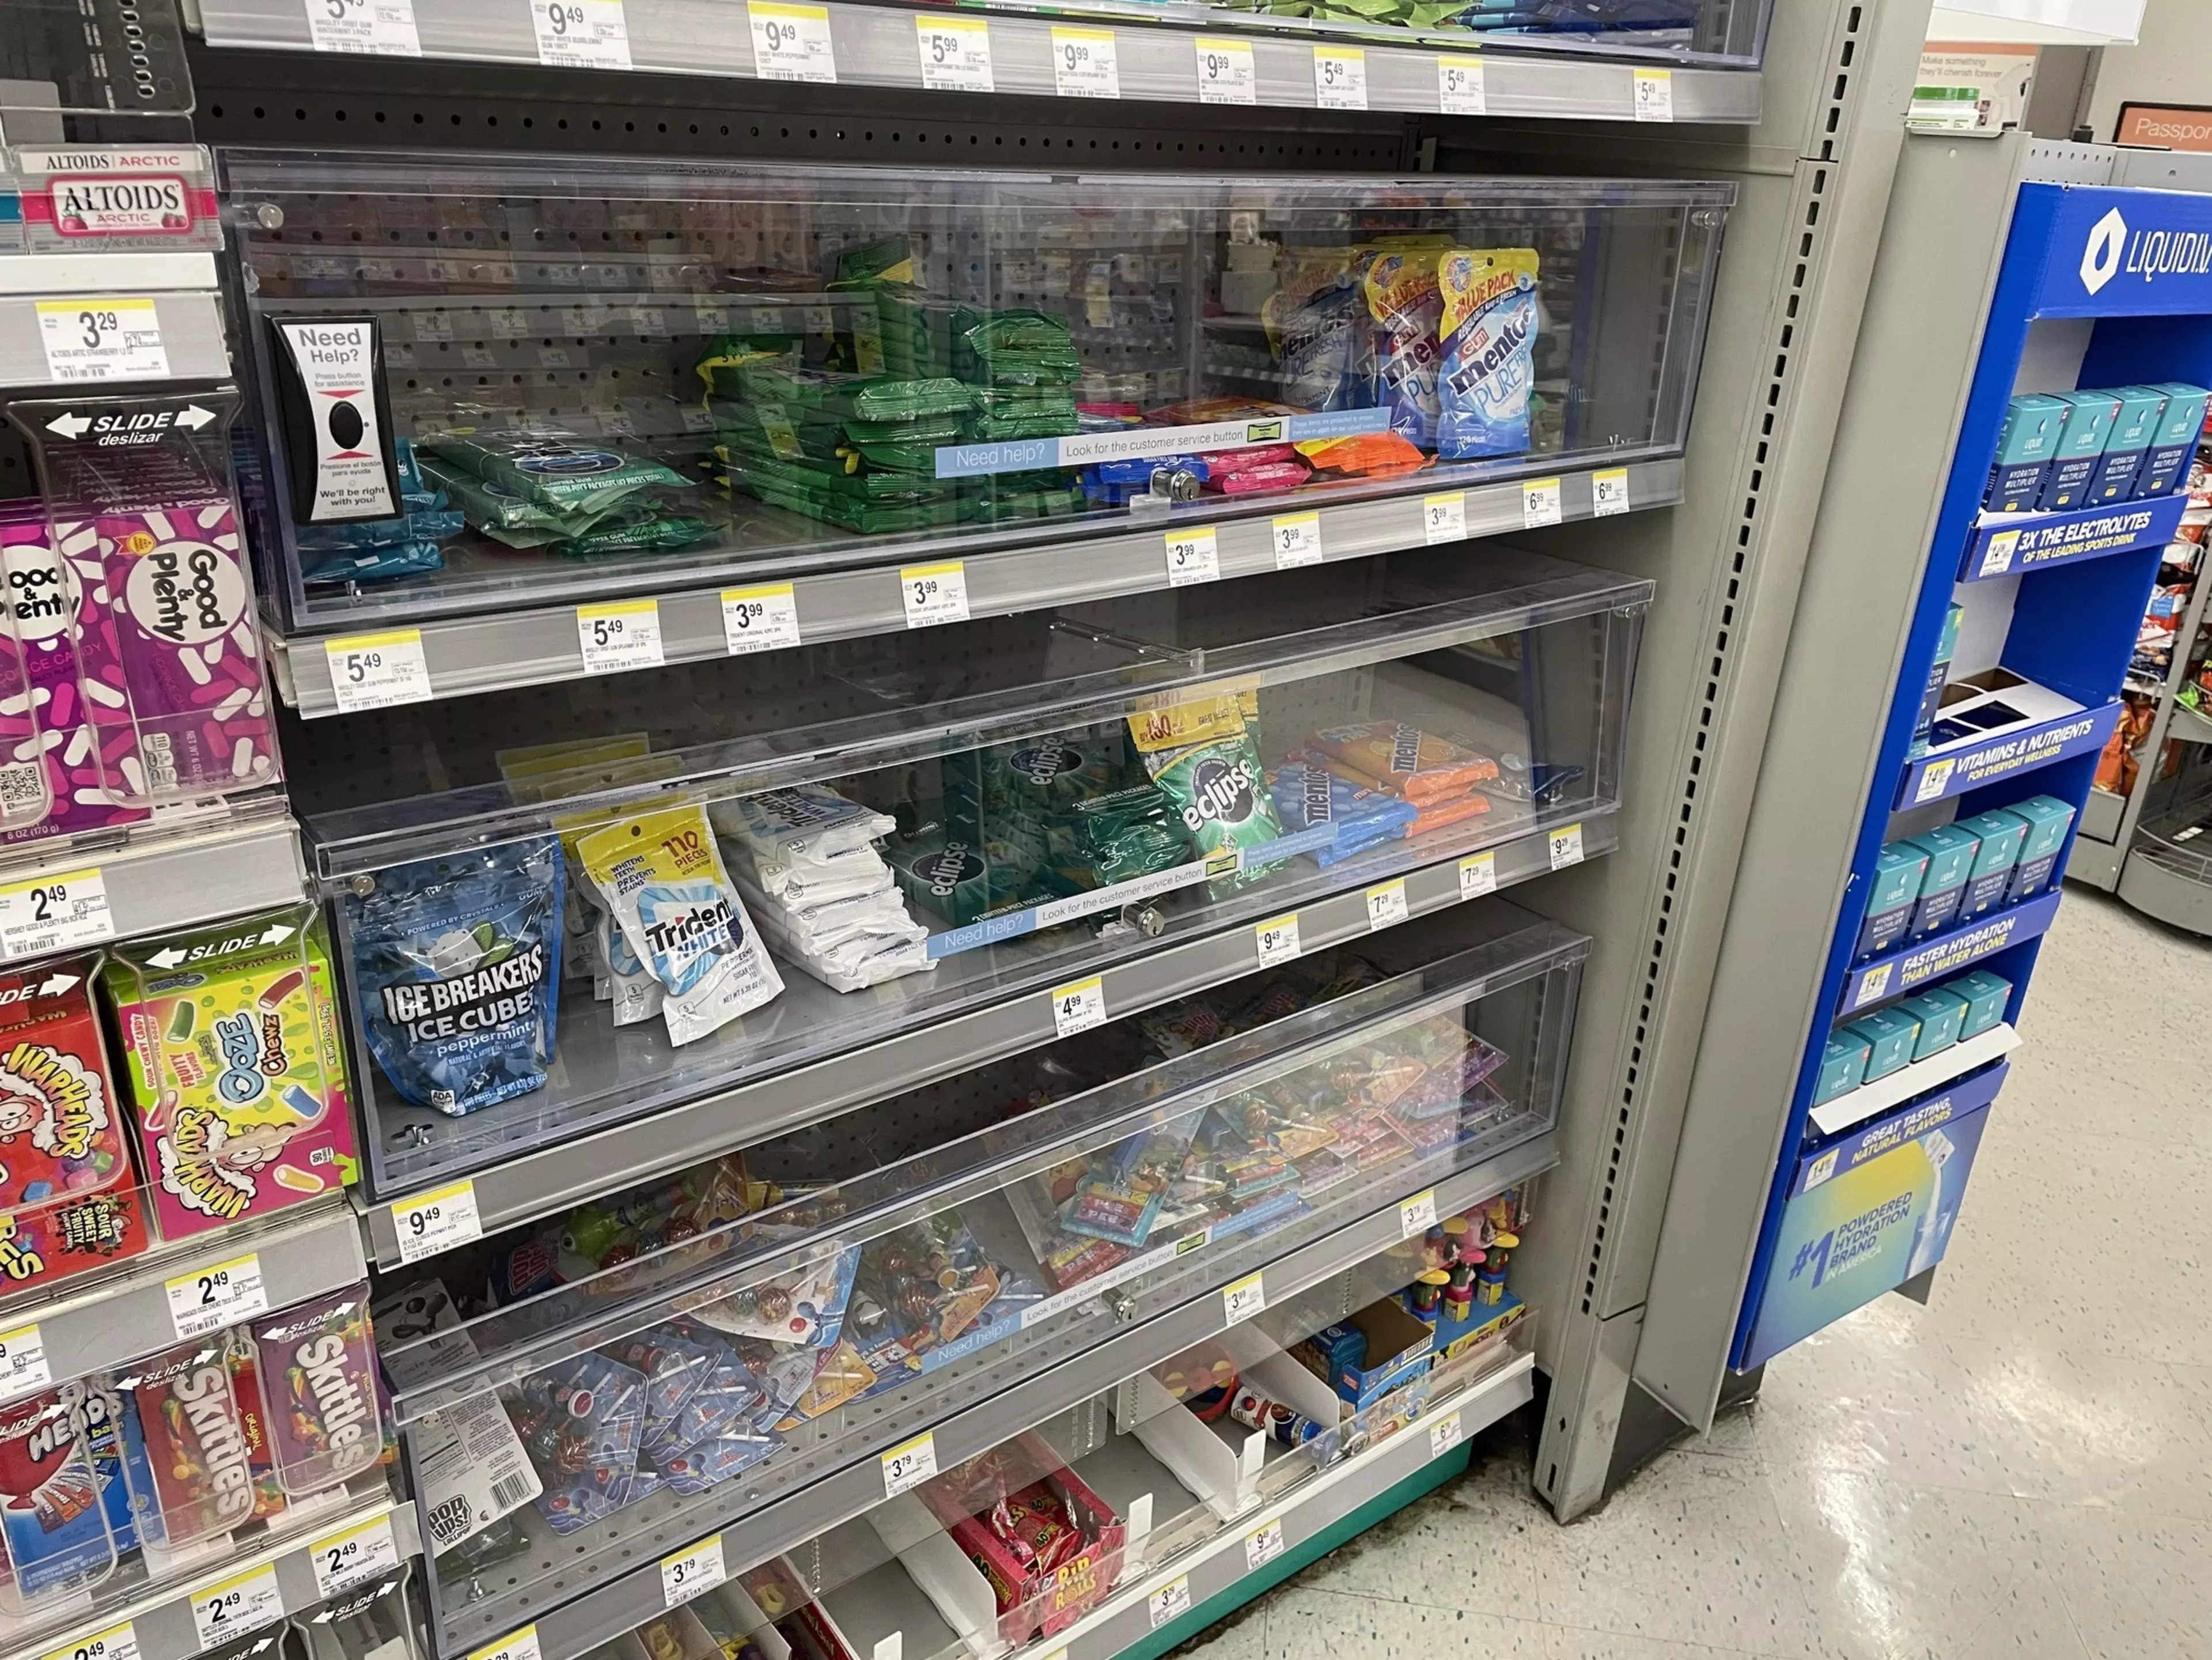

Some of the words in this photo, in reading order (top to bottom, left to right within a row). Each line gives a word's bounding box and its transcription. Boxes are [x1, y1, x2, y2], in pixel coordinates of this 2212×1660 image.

[47, 154, 109, 170] ALTOIDS
[120, 156, 180, 166] ARCTIC
[65, 184, 179, 211] ALTOIDS
[97, 214, 150, 222] ARCTIC
[1487, 269, 1516, 296] PACK
[298, 328, 361, 346] Need
[1462, 329, 1488, 356] GUM
[311, 349, 359, 365] Help?
[1475, 357, 1522, 411] PURE
[93, 413, 172, 432] SLIDE
[99, 431, 164, 447] deslizar
[1066, 442, 1090, 457] Look
[1094, 441, 1108, 454] for
[1111, 438, 1127, 452] the
[1130, 436, 1175, 451] customer
[1178, 433, 1210, 448] service
[1213, 429, 1243, 444] button
[956, 448, 999, 467] Need
[1003, 443, 1046, 466] help?
[320, 488, 344, 498] We'll
[362, 486, 385, 497] right
[331, 498, 353, 506] with
[355, 496, 376, 506] you!
[2018, 531, 2038, 551] 3X
[2039, 527, 2064, 547] THE
[2063, 511, 2153, 542] ELECTROLYTES
[2023, 551, 2035, 564] OF
[2036, 549, 2051, 561] THE
[2051, 542, 2084, 558] LEADING
[2084, 536, 2113, 552] SPORTS
[2113, 532, 2137, 547] DRINK
[24, 587, 37, 600] &
[149, 553, 188, 641] Plenty
[178, 589, 194, 602] &
[188, 550, 227, 629] Good
[1029, 737, 1065, 785] eclipse
[1391, 723, 1422, 773] mentos
[1957, 743, 2016, 773] VITAMINS
[2016, 739, 2027, 754] &
[2027, 719, 2094, 751] NUTRIENTS
[1967, 767, 1984, 782] FOR
[1984, 758, 2024, 778] EVERYDAY
[2024, 745, 2062, 765] WELLNESS
[1183, 759, 1256, 832] eclipse
[1304, 764, 1332, 827] mentos
[7, 831, 14, 840] 6
[16, 830, 28, 838] OZ
[31, 826, 48, 837] (170
[661, 831, 698, 857] 110
[611, 856, 645, 874] WHITENS
[614, 867, 635, 879] TEETH
[675, 849, 709, 868] PIECES
[930, 841, 968, 897] eclipse
[617, 868, 656, 888] PREVENTS
[1043, 909, 1066, 921] Look
[1068, 903, 1081, 914] for
[1083, 898, 1097, 910] the
[1099, 888, 1141, 905] customer
[1143, 877, 1173, 891] service
[1176, 867, 1202, 883] button
[407, 920, 446, 936] POWERED
[448, 916, 459, 925] BY
[645, 897, 733, 952] Trident
[945, 926, 982, 950] Need
[986, 914, 1024, 939] help?
[188, 933, 258, 961] SLIDE
[1900, 965, 1931, 985] THAN
[1934, 949, 1969, 972] WATER
[1971, 933, 2008, 958] ALONE
[1902, 945, 1948, 973] FASTER
[1948, 917, 2016, 954] HYDRATION
[384, 985, 431, 1024] ICE
[431, 944, 542, 1012] BREAKERS
[132, 1015, 147, 1039] CANDY
[407, 1016, 454, 1043] ICE
[459, 987, 535, 1031] CUBES
[139, 1041, 151, 1066] CHEWY
[261, 1014, 287, 1077] Chewz
[437, 1022, 533, 1056] peppermint
[169, 1053, 195, 1088] FRUITY
[185, 1051, 204, 1079] FLAVORS
[218, 1012, 264, 1103] OOZE
[144, 1068, 156, 1088] SOUR
[6, 1042, 92, 1159] WARHEADS
[433, 1092, 452, 1100] ADA
[1851, 1136, 1901, 1164] NATURAL
[1904, 1110, 1952, 1139] FLAVORS
[1862, 1121, 1902, 1147] GREAT
[70, 1211, 84, 1244] FRUITY
[79, 1207, 97, 1243] SWEET
[95, 1204, 113, 1241] SOUR
[1835, 1204, 1911, 1250] HYDRATION
[1838, 1191, 1912, 1235] POWDERED
[1788, 1230, 1834, 1290] #1
[1830, 1235, 1877, 1267] BRAND
[1836, 1247, 1882, 1277] AMERICA
[1027, 1307, 1049, 1321] Look
[1051, 1300, 1063, 1312] for
[1064, 1294, 1076, 1306] the
[1080, 1280, 1116, 1300] customer
[1119, 1265, 1146, 1283] service
[1148, 1249, 1174, 1267] button
[289, 1311, 333, 1333] SLIDE
[938, 1340, 974, 1361] Need
[976, 1319, 1010, 1348] help?
[144, 1359, 192, 1383] SLIDE
[146, 1372, 185, 1390] deslizar
[297, 1334, 367, 1470] Skittles
[173, 1366, 251, 1515] Skittles
[428, 1498, 463, 1528] pop
[443, 1526, 471, 1546] LOLLIPOP
[335, 1591, 376, 1616] SLIDE
[1056, 1572, 1096, 1610] ROLLS
[338, 1604, 372, 1622] deslizar
